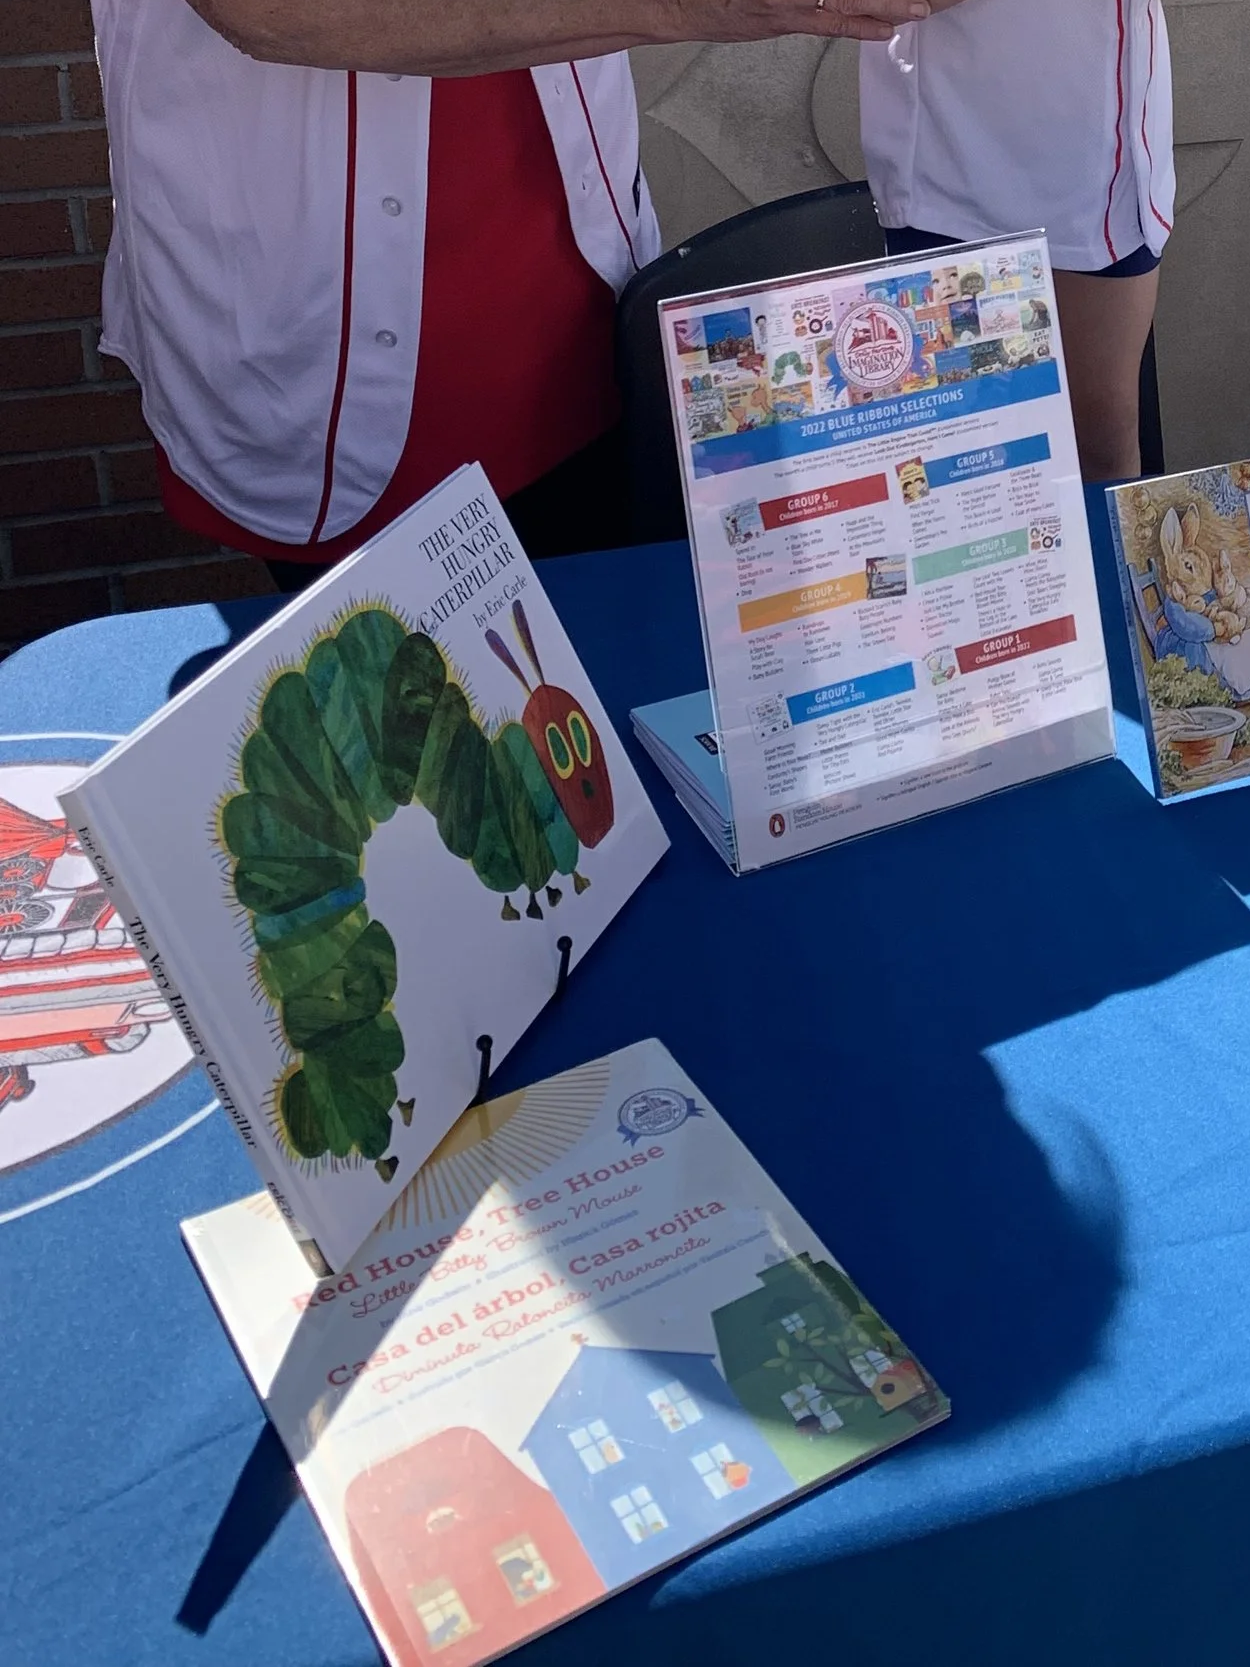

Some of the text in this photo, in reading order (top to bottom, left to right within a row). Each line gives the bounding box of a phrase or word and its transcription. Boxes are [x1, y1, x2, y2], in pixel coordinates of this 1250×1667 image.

[801, 388, 964, 437] 2022 BLUE RIBBON SELECTIONS
[832, 409, 938, 441] UNITED STATES OF AMERICA
[956, 452, 984, 468] GROUP
[418, 492, 490, 563] THE VERY
[787, 491, 829, 511] GROUP 6
[441, 516, 501, 581] HUNGRY
[418, 541, 516, 634] CATERPILLAR
[472, 573, 528, 629] by Eric Carle
[800, 585, 834, 602] GROUP
[982, 633, 1022, 654] GROUP 1
[815, 687, 848, 704] GROUP
[77, 826, 116, 889] Eric Carle
[129, 916, 259, 1150] The Very Hungry Caterpillar
[292, 1271, 362, 1314] Red
[364, 1226, 485, 1283] House,
[486, 1188, 561, 1226] Tree
[564, 1145, 665, 1195] House
[350, 1280, 417, 1319] Little
[419, 1253, 488, 1282] Bitty
[486, 1217, 568, 1252] Brown
[568, 1184, 643, 1221] Mouse
[326, 1343, 410, 1387] Casa
[415, 1312, 468, 1347] del
[472, 1271, 565, 1321] árbol,
[568, 1234, 644, 1275] Casa
[645, 1200, 727, 1243] rojita
[372, 1342, 482, 1394] Diminuta
[483, 1290, 592, 1342] Ratoncita
[592, 1236, 712, 1292] Marroncita
